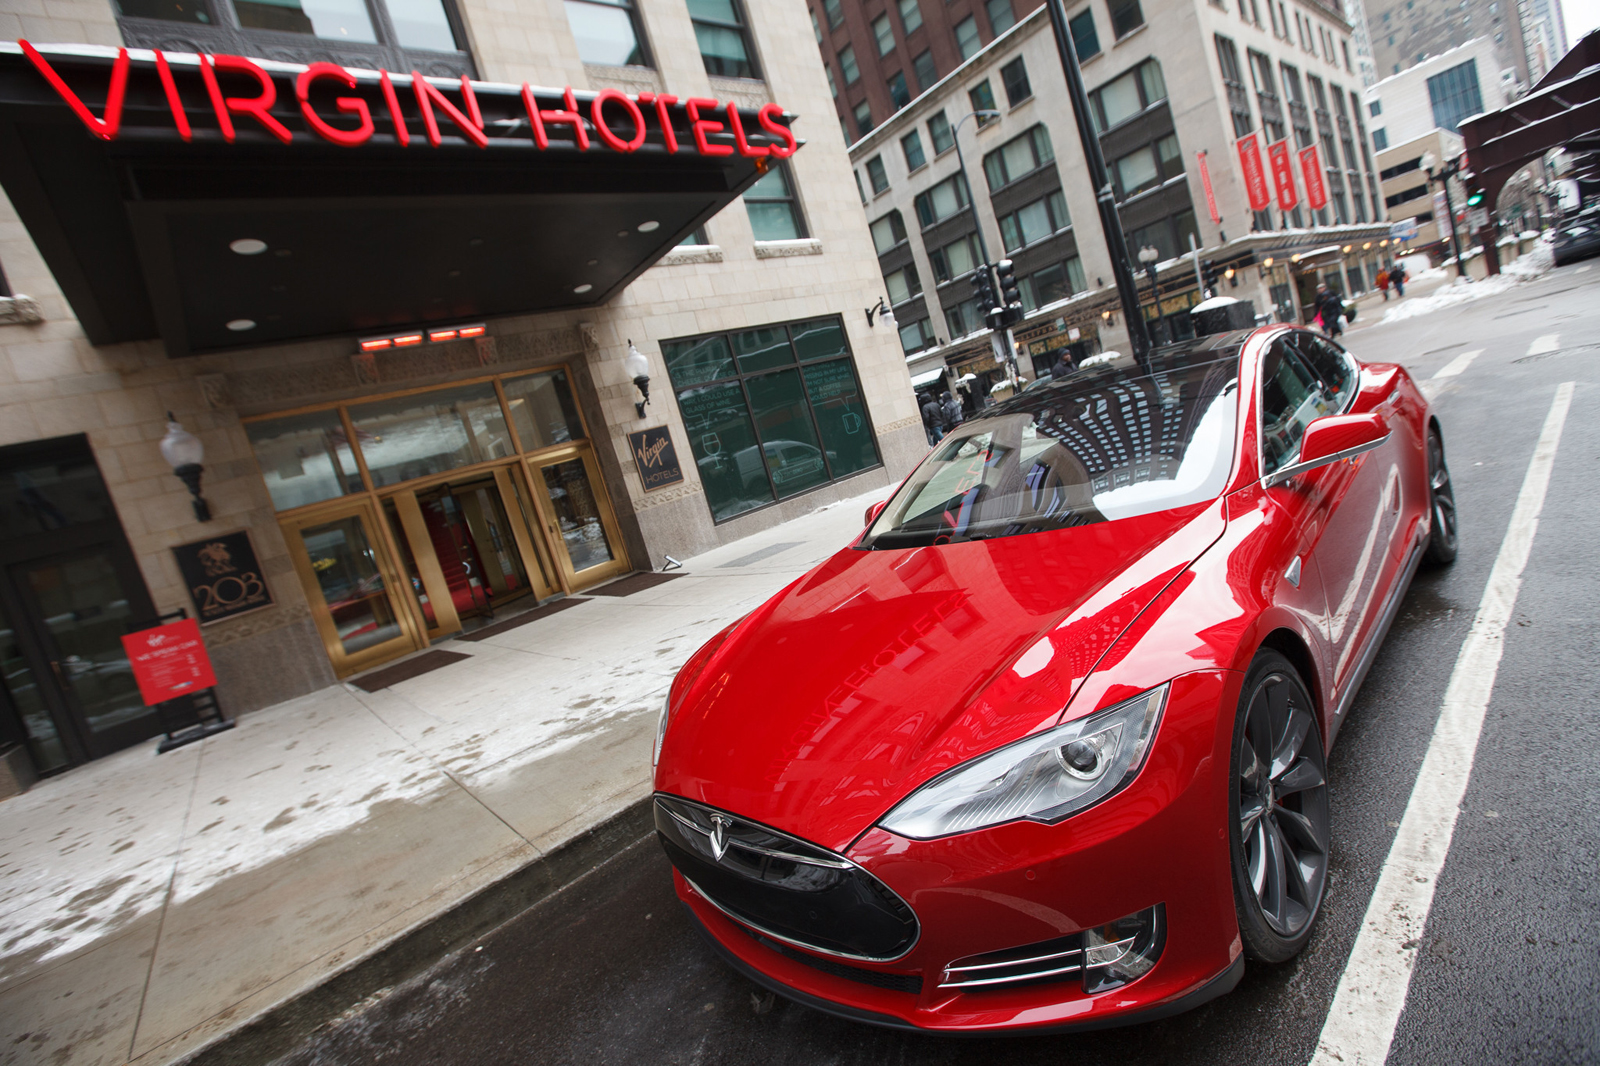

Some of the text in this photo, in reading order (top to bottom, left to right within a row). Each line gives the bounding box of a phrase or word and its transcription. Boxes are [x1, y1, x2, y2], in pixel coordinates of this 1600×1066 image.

[17, 39, 797, 159] VIRGIN HOTELS
[685, 404, 706, 414] GLASS
[700, 392, 722, 402] COULD
[638, 434, 668, 468] Virgin
[645, 467, 679, 484] HOTELS
[194, 572, 264, 611] 203
